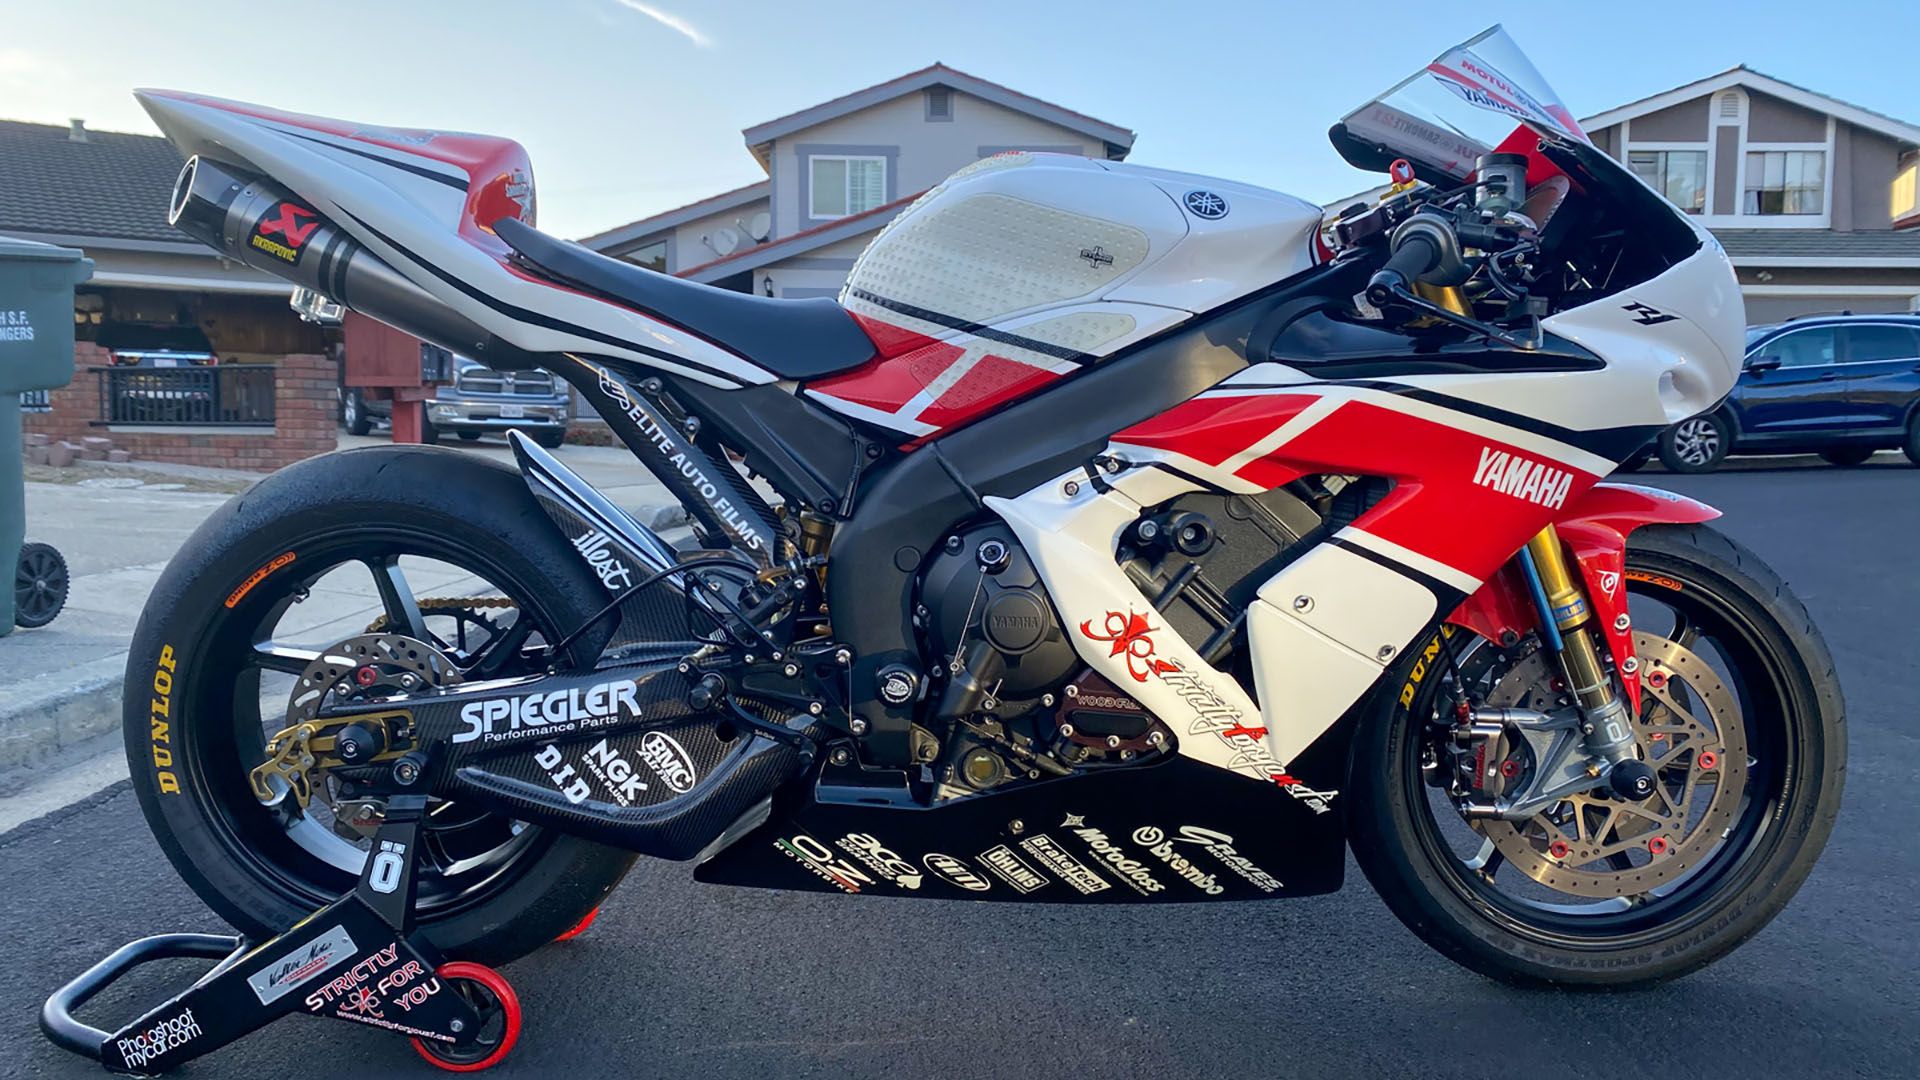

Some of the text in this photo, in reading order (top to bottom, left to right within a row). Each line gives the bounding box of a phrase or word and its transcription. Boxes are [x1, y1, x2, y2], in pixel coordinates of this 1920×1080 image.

[8, 310, 29, 325] S.F.
[628, 404, 764, 550] ELITE AUTO FILMS
[1472, 446, 1574, 510] YAMAHA
[151, 643, 180, 794] DUNLOP
[452, 679, 642, 744] SPIEGLER
[484, 715, 618, 743] Performance Parts
[582, 754, 630, 807] SPARK PLUGS
[588, 738, 648, 801] NGK
[645, 735, 692, 788] BMC
[773, 841, 854, 894] MOTORBIKE
[846, 833, 919, 876] ace
[987, 848, 1043, 889] ÖHLINS
[1150, 840, 1224, 895] brembo
[1205, 845, 1275, 893] MOTORSPORTS
[305, 942, 399, 1012] STRICTLY
[377, 960, 424, 996] FOR
[393, 977, 441, 1012] YOU
[123, 1022, 202, 1069] mycar.com
